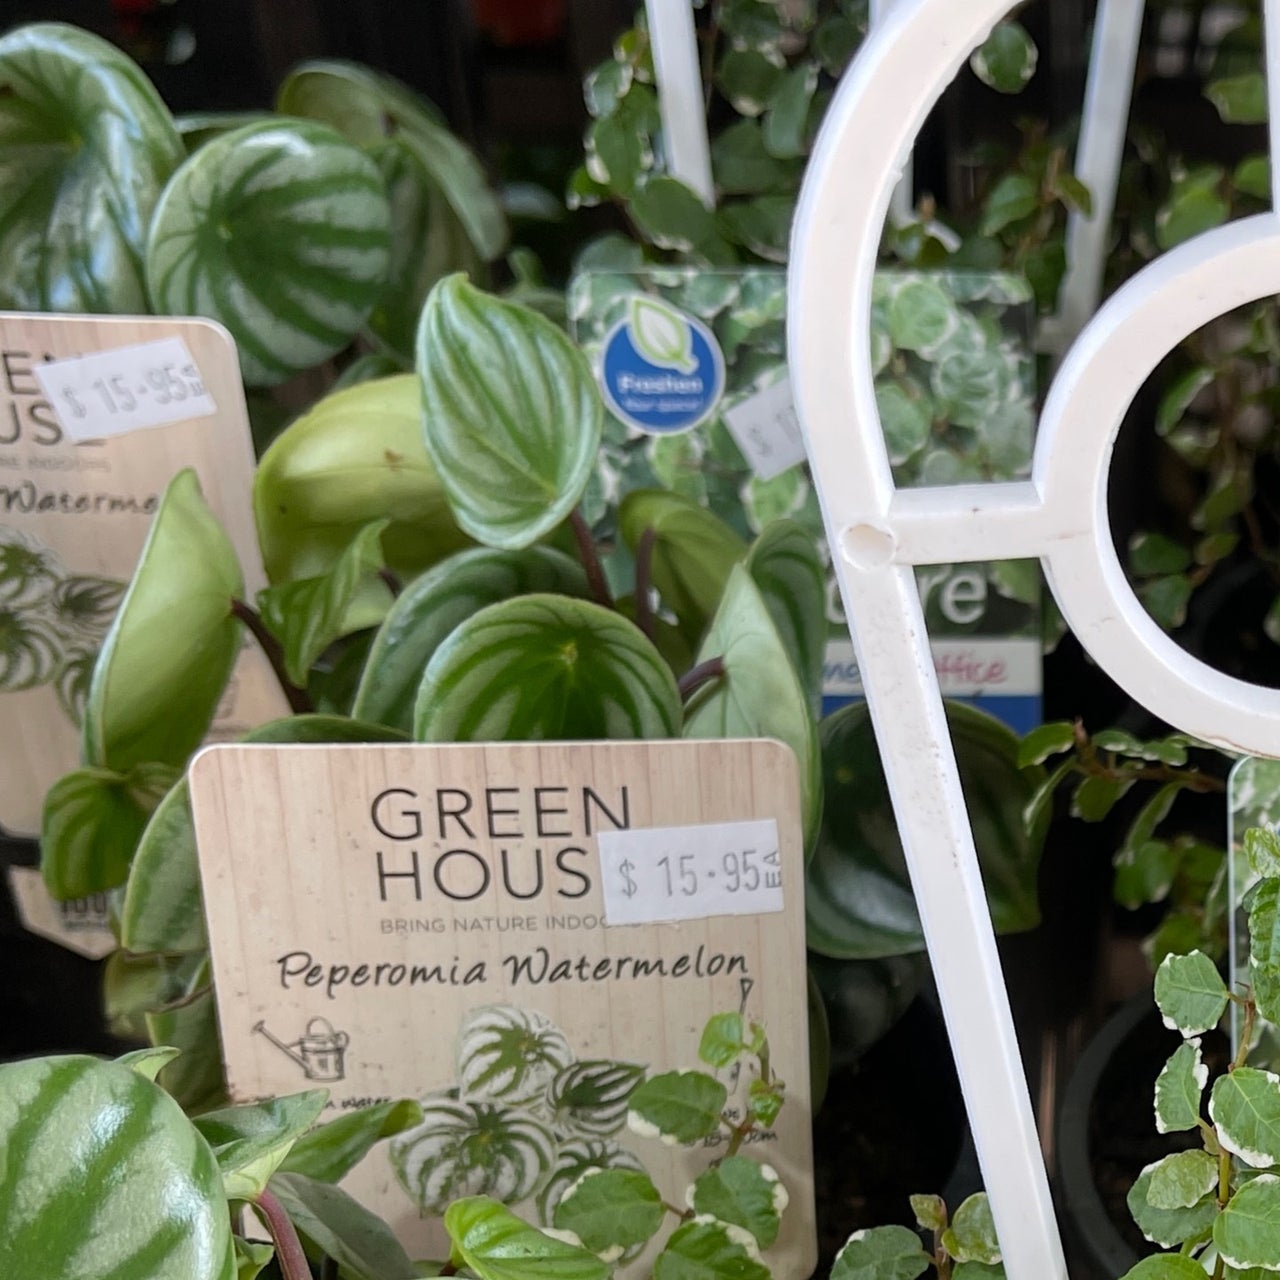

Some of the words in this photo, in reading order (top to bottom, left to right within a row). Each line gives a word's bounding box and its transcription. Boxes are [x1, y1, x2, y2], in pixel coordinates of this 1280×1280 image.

[371, 786, 630, 842] GREEN
[376, 847, 591, 902] HOUS
[618, 859, 638, 898] $
[381, 917, 446, 934] BRING
[453, 916, 538, 932] NATURE
[277, 951, 487, 999] Peperomia
[503, 944, 748, 985] Watermelon
